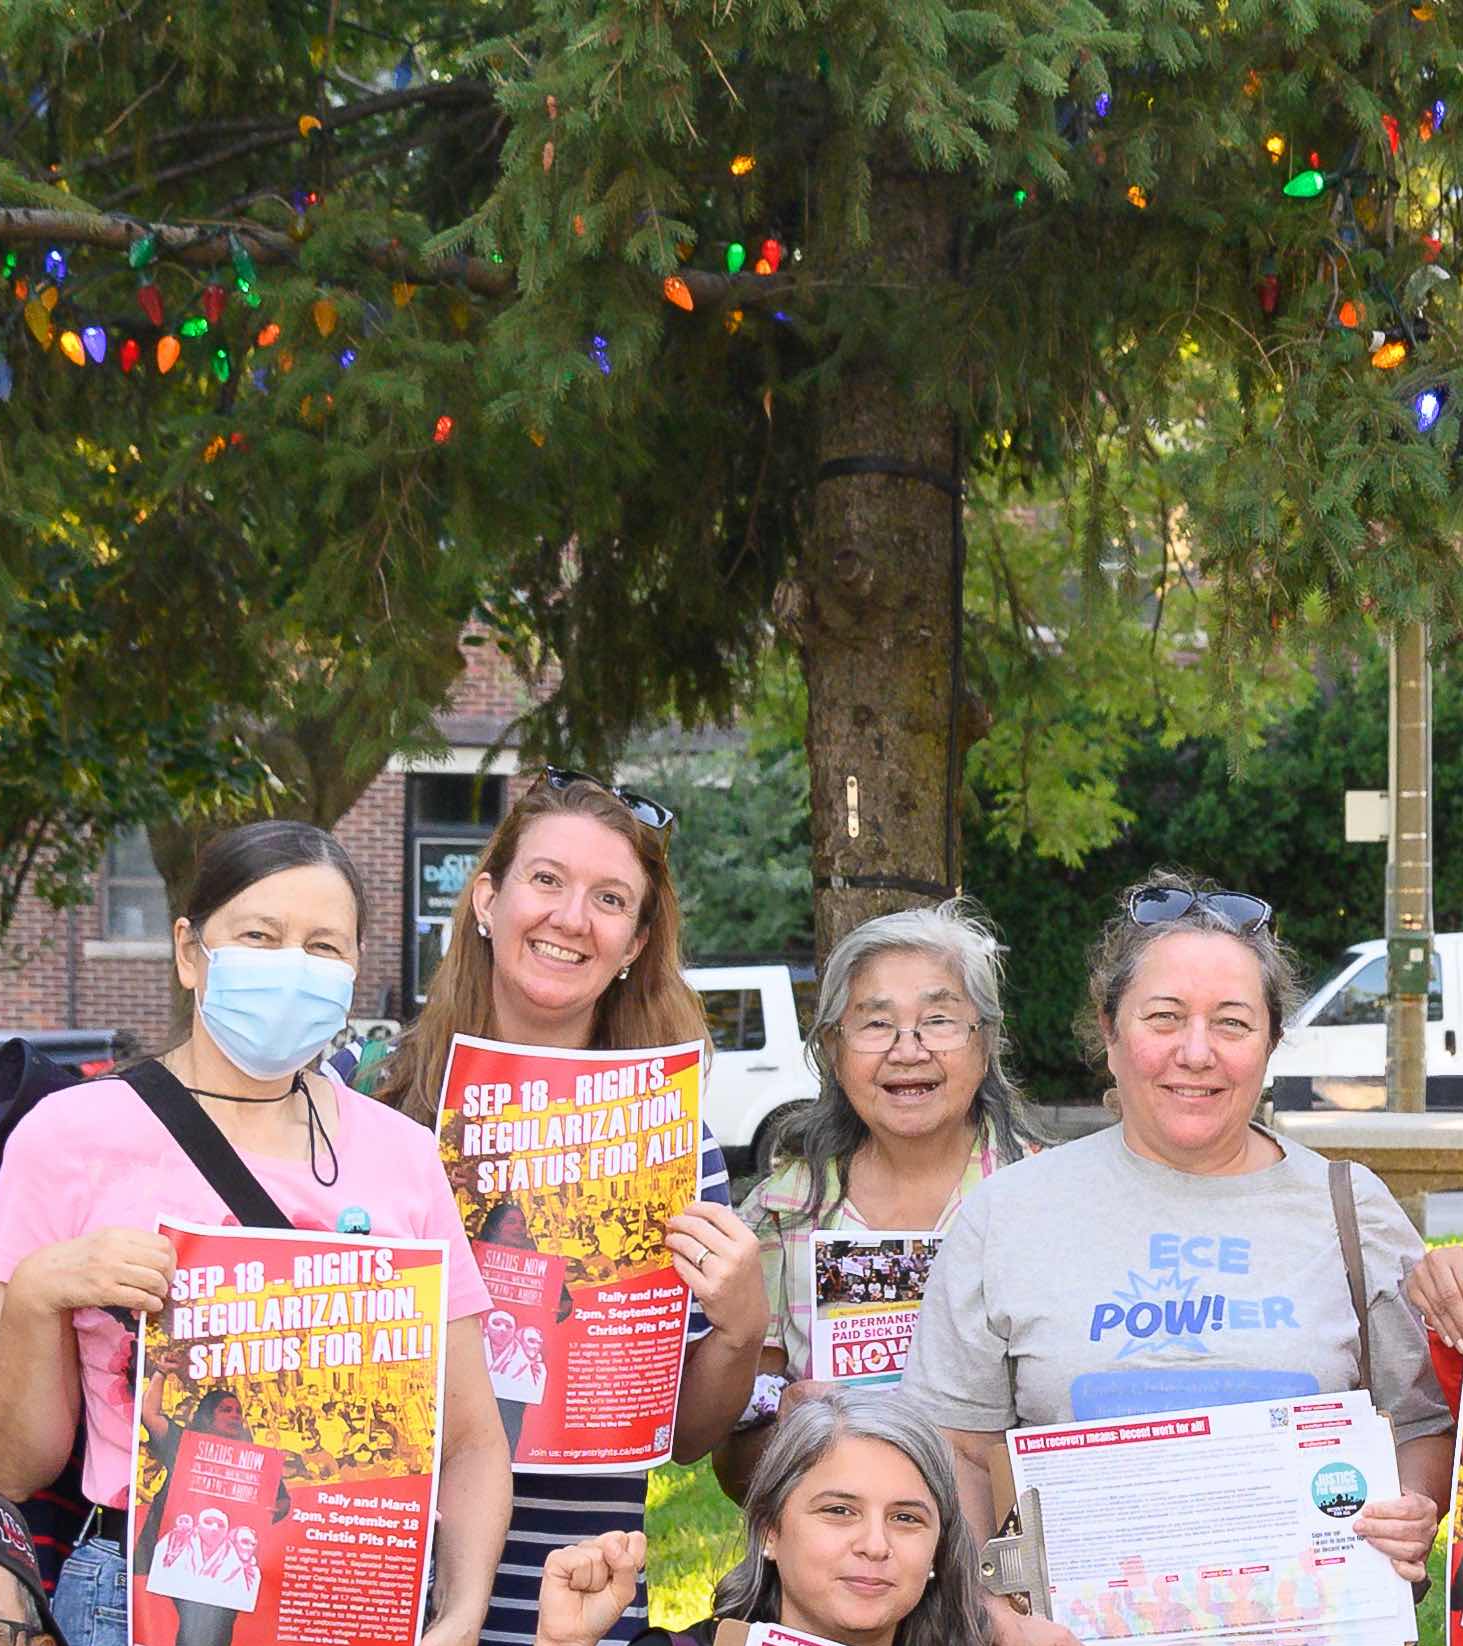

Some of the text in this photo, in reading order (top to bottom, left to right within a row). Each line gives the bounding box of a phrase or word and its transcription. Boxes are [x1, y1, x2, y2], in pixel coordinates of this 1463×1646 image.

[463, 1057, 671, 1118] SEP 18 RIGHTS.
[463, 1089, 687, 1156] REGULARIZATION.
[476, 1121, 693, 1195] STATUS FOR ALL!
[1149, 1232, 1251, 1274] ECE
[171, 1249, 401, 1302] SEP 18 RIGHTS.
[172, 1285, 422, 1340] REGULARIZATION.
[832, 1323, 916, 1342] PAID SICK DA
[833, 1312, 920, 1331] 10 PERMANEN
[189, 1324, 433, 1381] STATUS FOR ALL!
[1045, 1432, 1086, 1449] recovery
[1119, 1426, 1149, 1443] Decent
[1151, 1422, 1175, 1437] work
[1176, 1422, 1189, 1436] for
[292, 1509, 420, 1531] 2pm, September 18
[317, 1492, 421, 1513] Rally and March
[305, 1528, 417, 1549] Christie Pits Park
